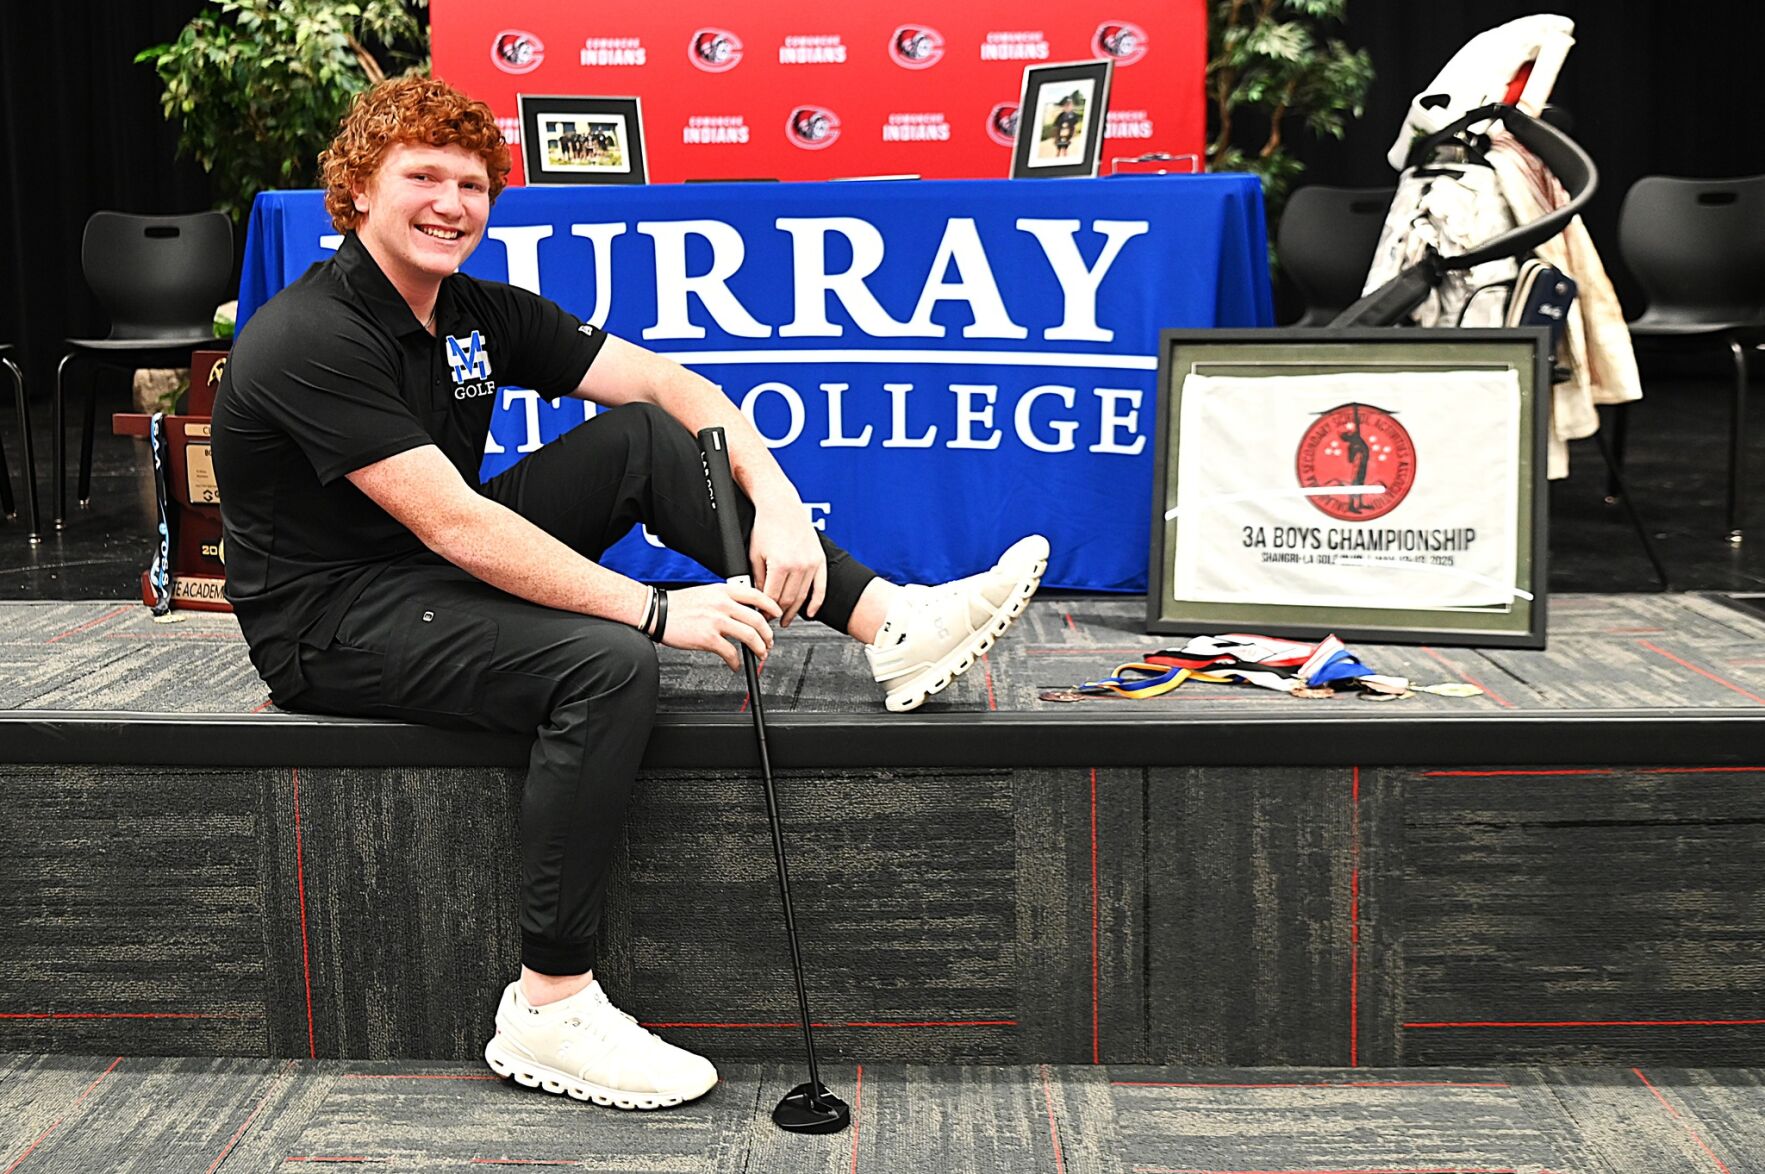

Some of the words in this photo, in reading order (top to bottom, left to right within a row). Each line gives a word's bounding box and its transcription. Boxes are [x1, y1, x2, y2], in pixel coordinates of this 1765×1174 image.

[580, 49, 646, 66] INDIANS
[779, 47, 847, 64] INDIANS
[980, 44, 1049, 60] INDIANS
[683, 127, 750, 144] INDIANS
[882, 124, 950, 141] INDIANS
[320, 216, 1149, 342] URRAY
[454, 380, 496, 400] GOLF
[730, 382, 1147, 455] OLLEGE
[1242, 526, 1267, 548] 3A
[1273, 527, 1321, 549] BOYS
[1327, 527, 1476, 551] CHAMPIONSHIP
